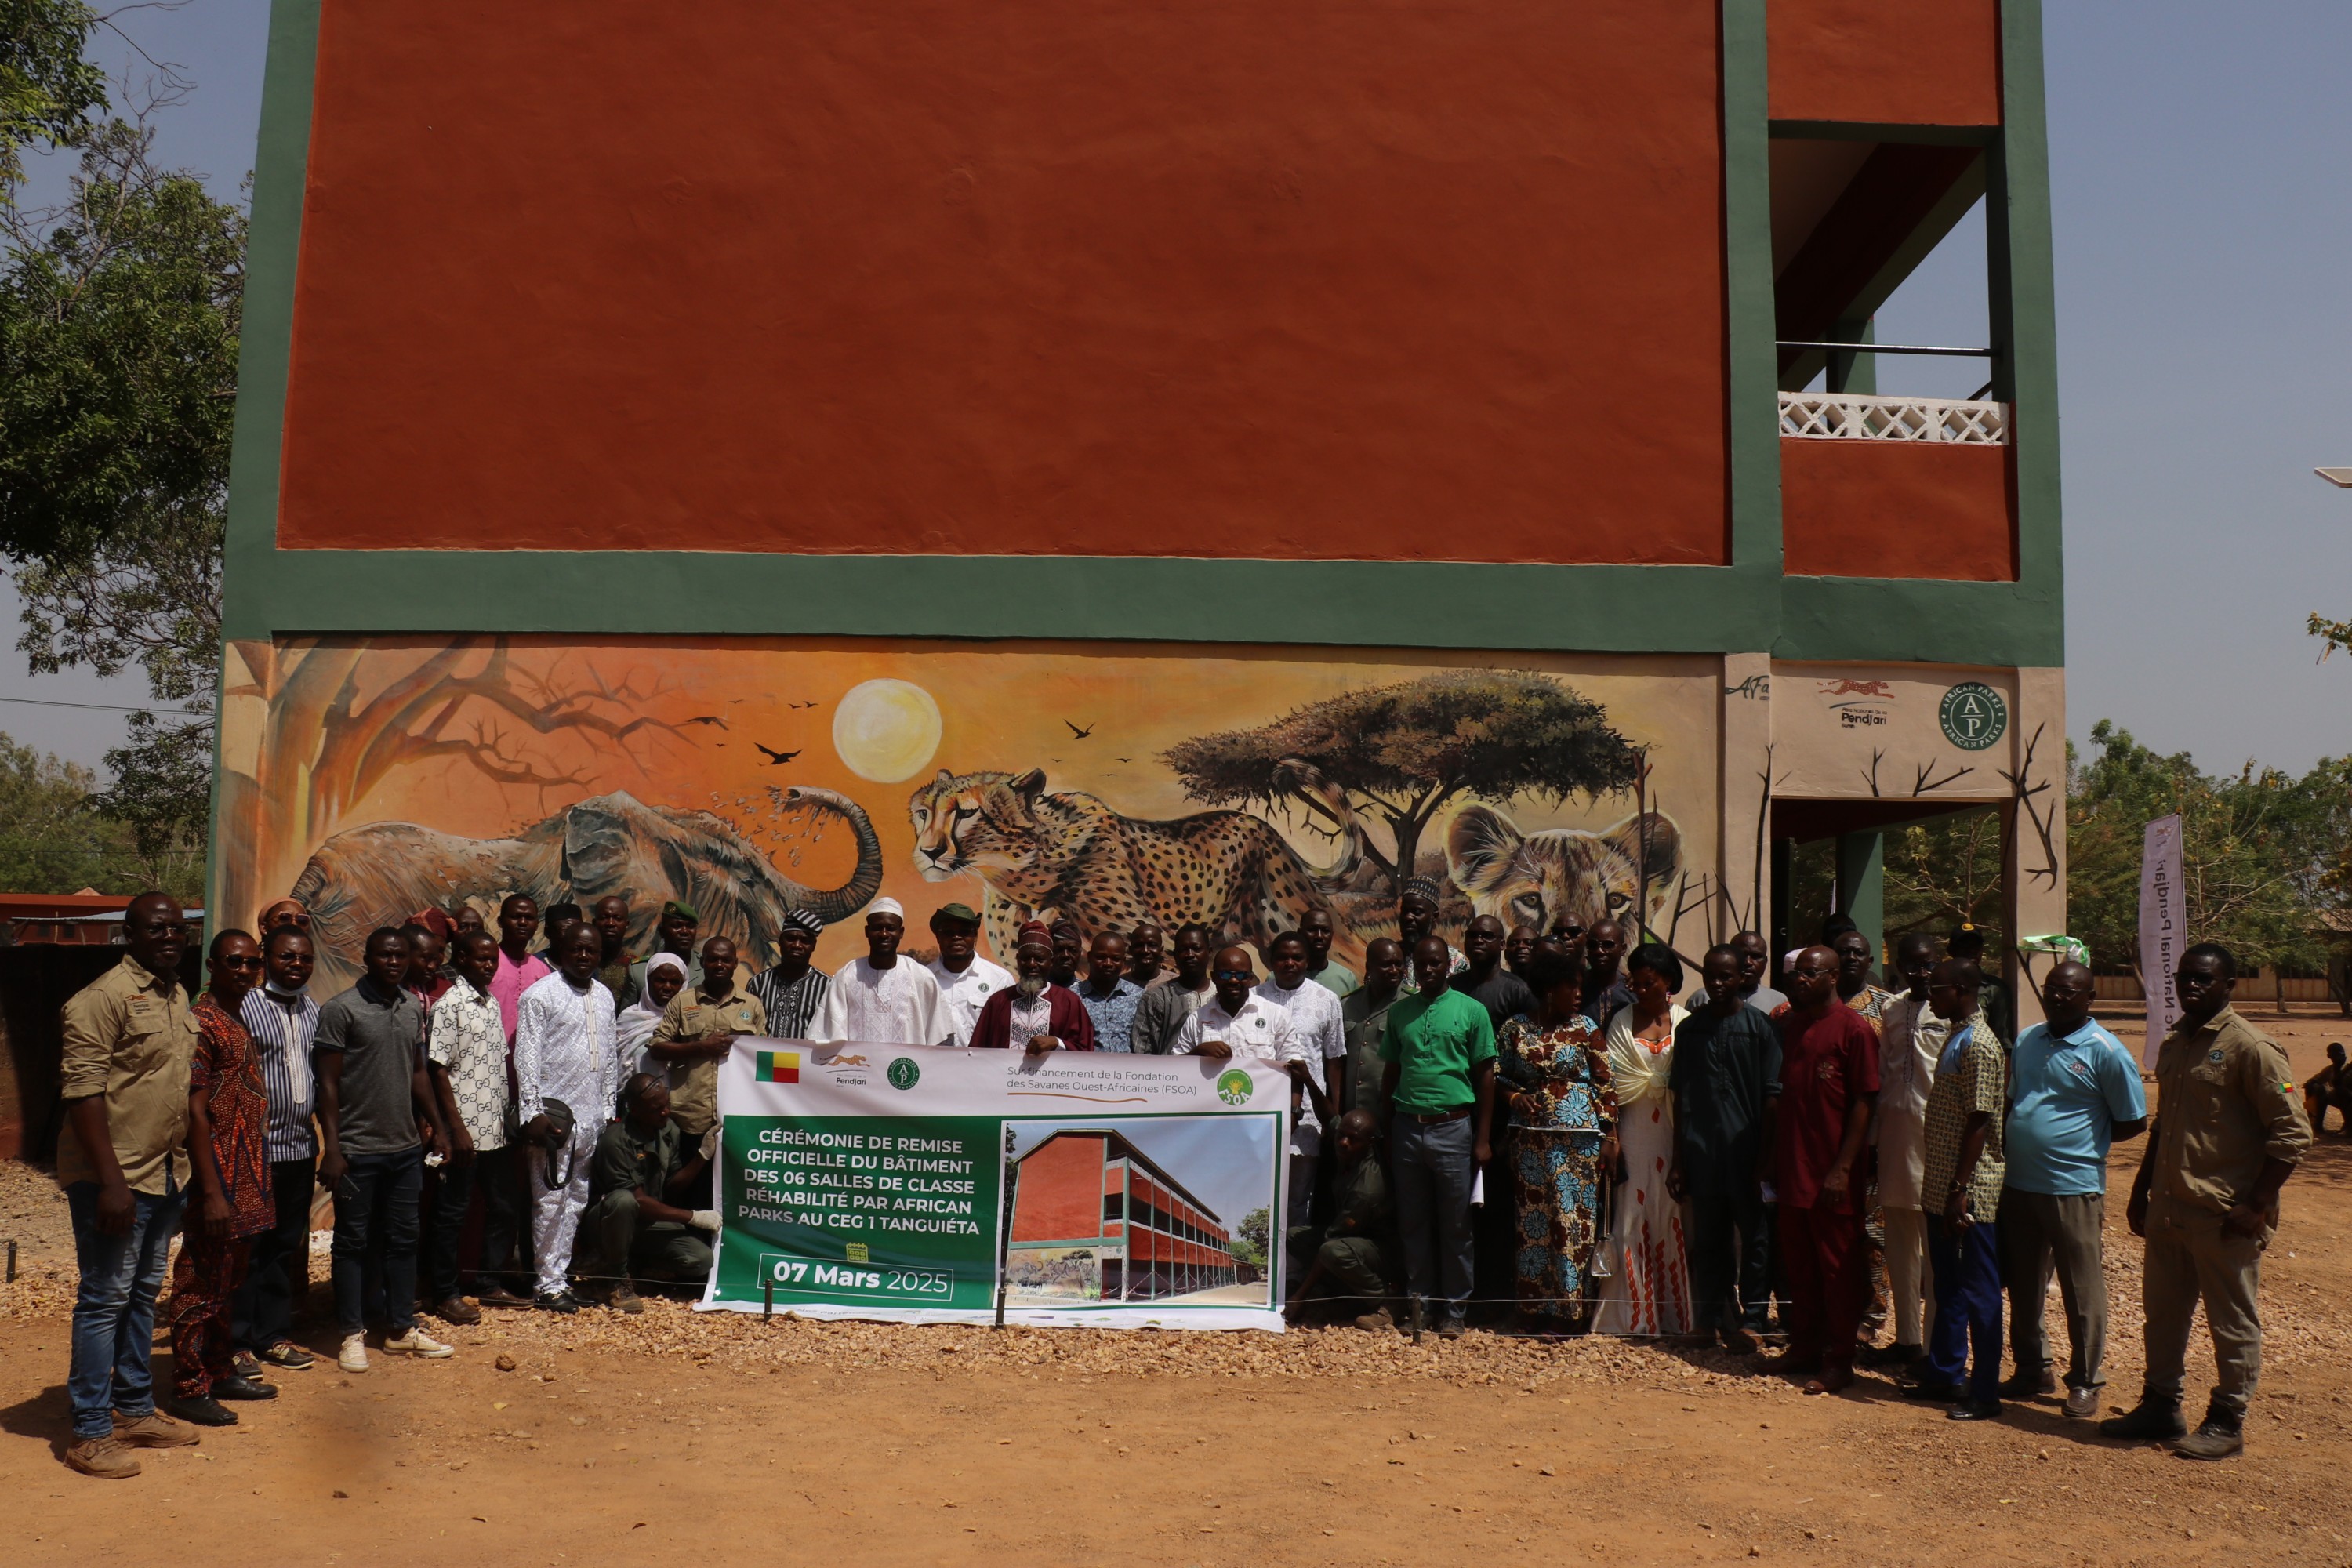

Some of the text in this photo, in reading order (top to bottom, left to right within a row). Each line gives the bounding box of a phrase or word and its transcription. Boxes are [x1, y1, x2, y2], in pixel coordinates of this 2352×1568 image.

[1943, 684, 2002, 709] AFRICAN PARKS
[1963, 695, 1981, 713] A
[1842, 712, 1886, 726] Pendjari
[1965, 718, 1980, 737] P
[1943, 724, 2002, 748] AFRICAN PARKS
[898, 1064, 909, 1073] A
[1007, 1067, 1178, 1082] Sur financement de la Fondation
[836, 1077, 866, 1086] Pendjari
[900, 1075, 908, 1083] P
[1007, 1079, 1197, 1095] des Savanes Ouest-Africaines (FSOA)
[1218, 1088, 1251, 1105] FSOA
[759, 1128, 963, 1153] CÉRÉMONIE DE REMISE
[747, 1149, 974, 1174] OFFICIELLE DU BÂTIMENT
[744, 1168, 975, 1194] DES 06 SALLES DE CLASSE
[746, 1186, 971, 1214] RÉHABILITÉ PAR AFRICAN
[739, 1205, 979, 1235] PARKS AU CEG 1 TANGUIÉTA
[773, 1261, 948, 1293] 07 Mars 2025
